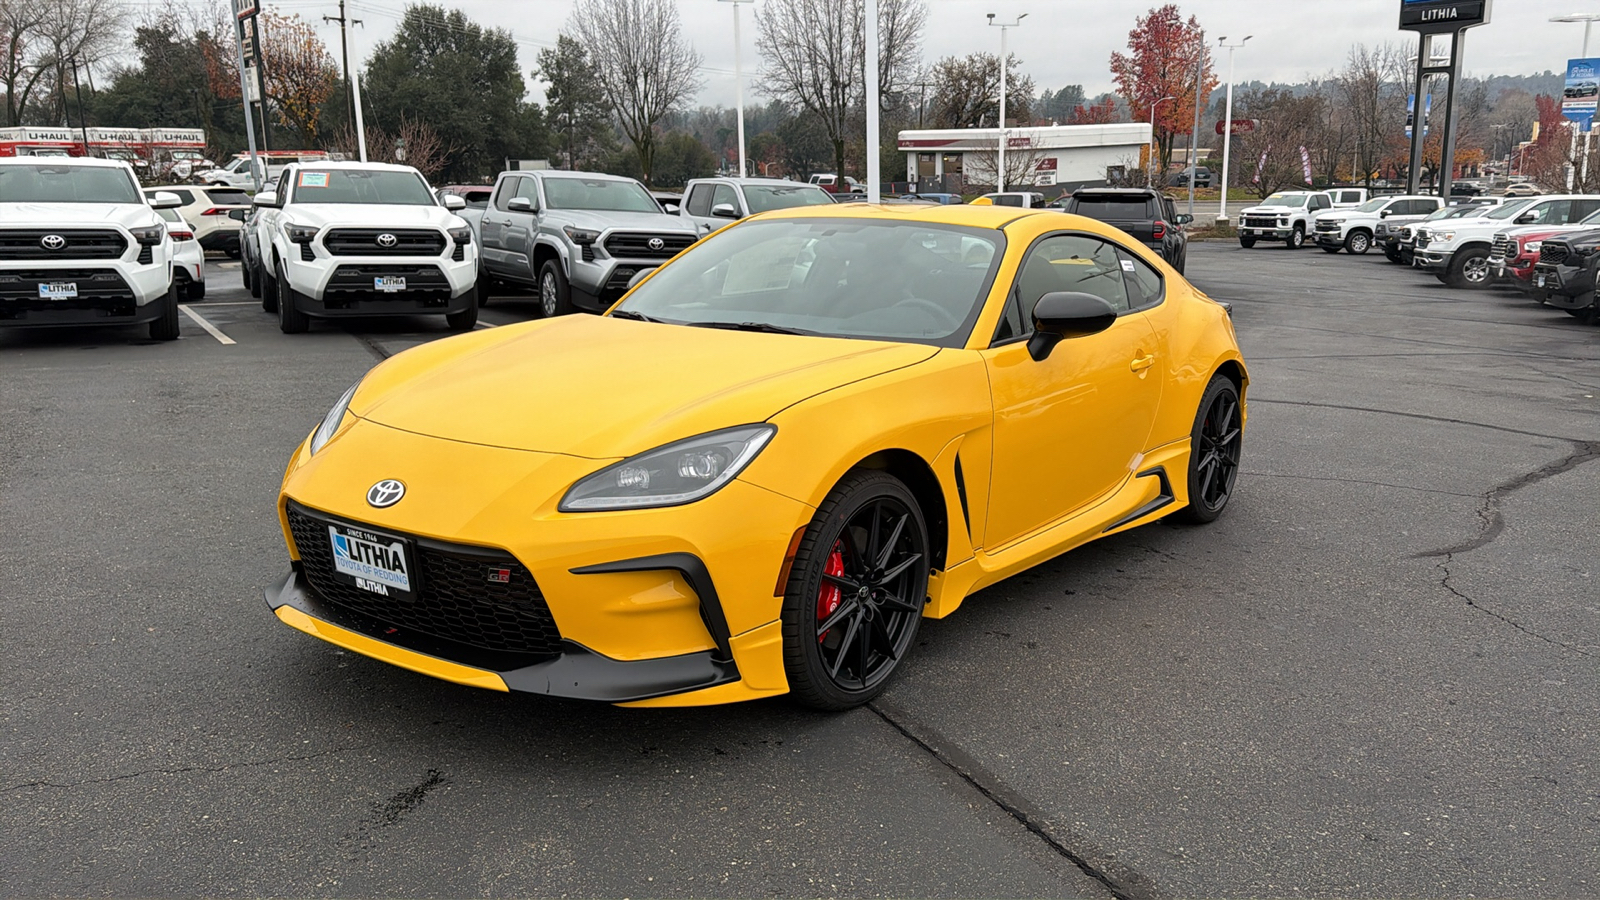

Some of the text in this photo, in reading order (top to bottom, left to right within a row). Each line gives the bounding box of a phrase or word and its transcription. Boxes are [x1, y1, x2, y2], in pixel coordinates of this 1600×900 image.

[1421, 7, 1458, 21] LITHIA
[99, 133, 137, 141] U-HAUL
[347, 528, 378, 542] SINCE 1946
[347, 538, 405, 574] LITHIA
[336, 556, 408, 585] TOYOTA OF REDDING
[363, 579, 389, 596] LITHIA
